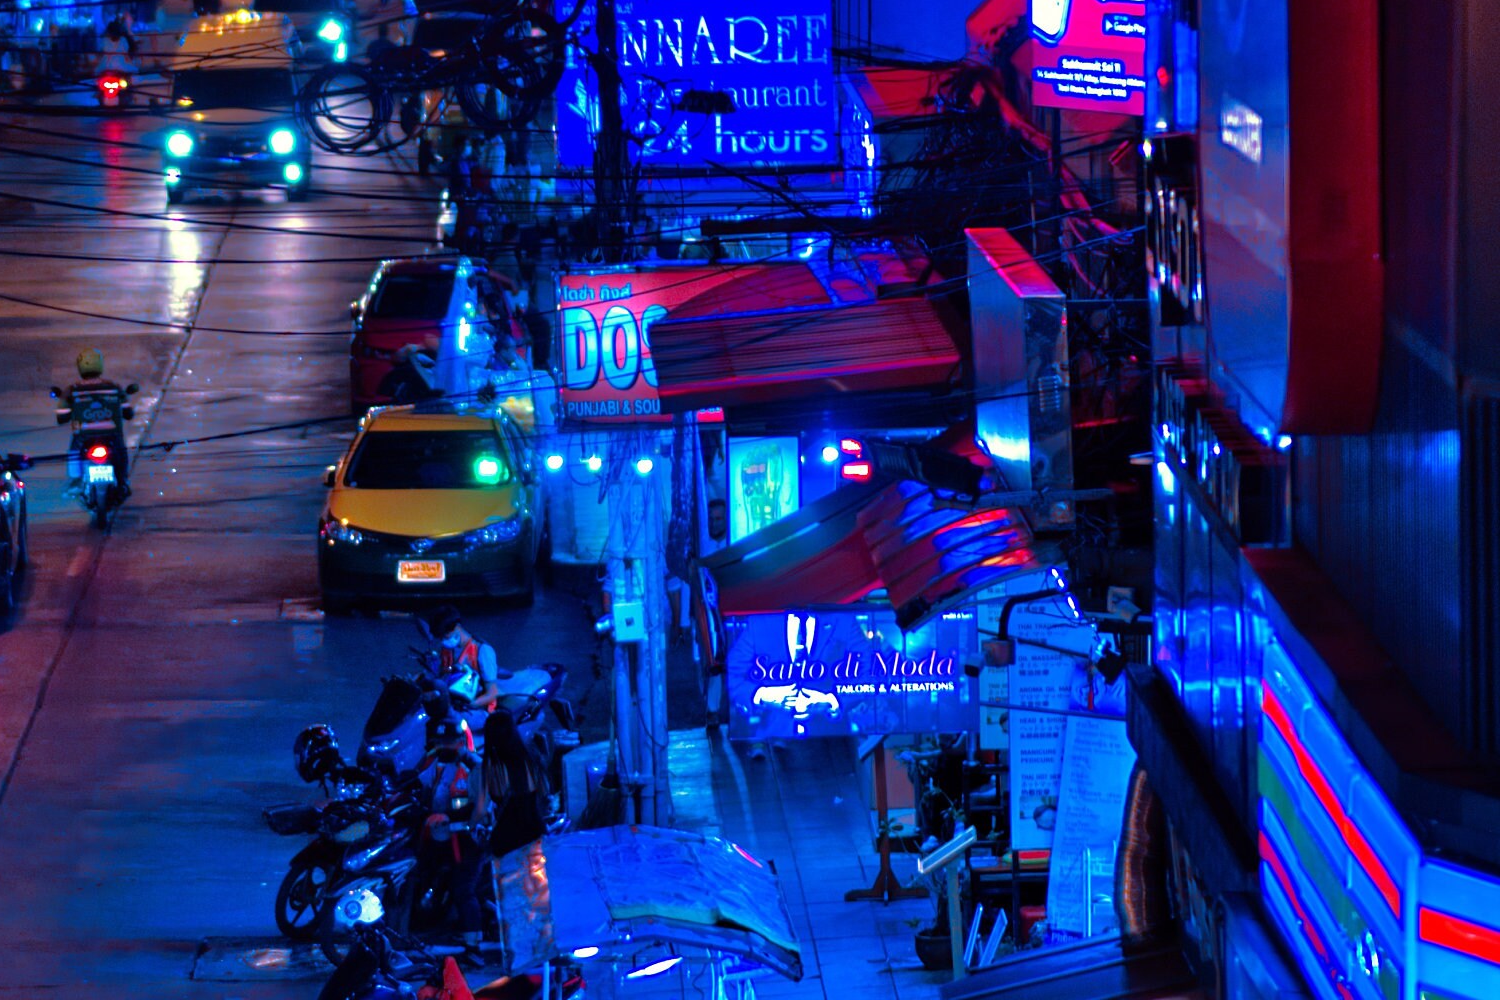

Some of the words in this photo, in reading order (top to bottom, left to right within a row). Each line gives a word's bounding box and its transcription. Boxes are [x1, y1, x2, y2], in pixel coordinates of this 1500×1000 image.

[715, 113, 829, 155] hours
[83, 407, 113, 421] Grab
[568, 400, 619, 417] PUNJABI
[622, 400, 631, 415] &
[834, 652, 861, 679] di
[869, 650, 956, 677] Moda
[836, 684, 876, 694] TAILORS
[879, 684, 887, 693] &
[890, 682, 955, 692] ALTERATIONS
